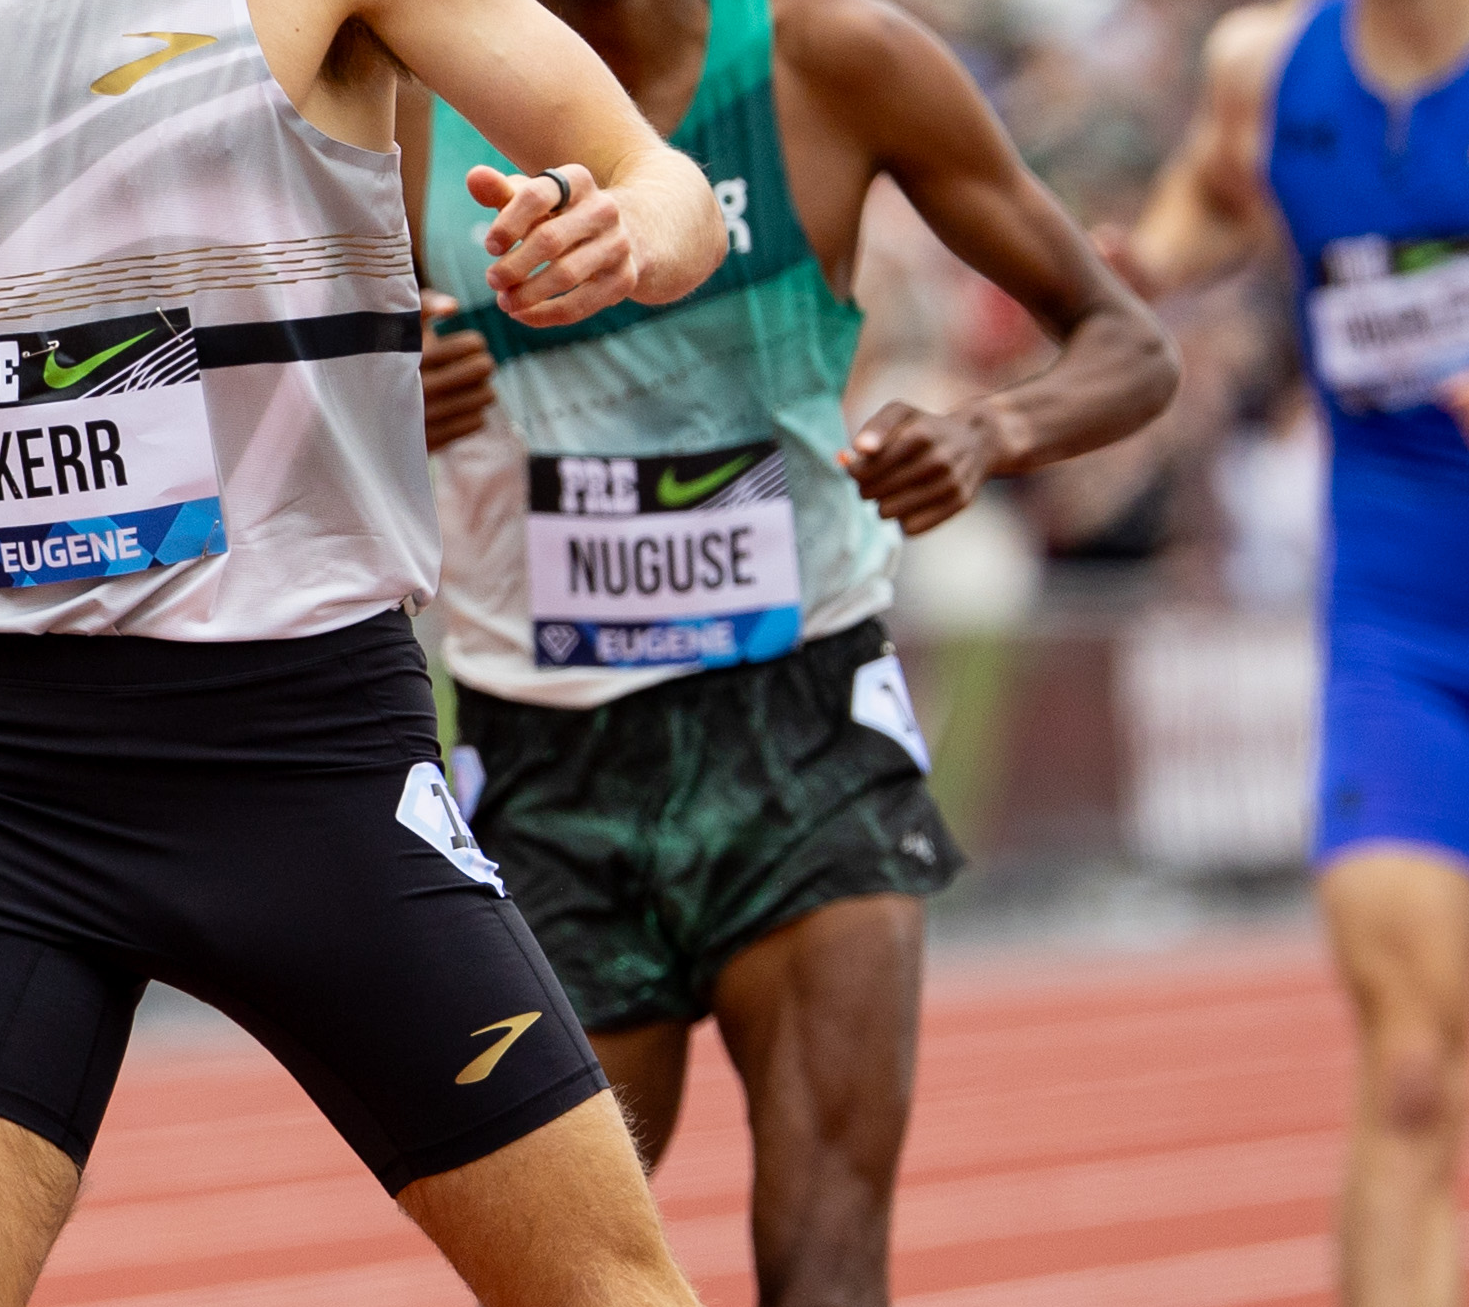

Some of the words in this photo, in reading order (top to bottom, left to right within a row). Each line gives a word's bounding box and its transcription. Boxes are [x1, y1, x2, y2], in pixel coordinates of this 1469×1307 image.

[559, 457, 639, 514] PRE
[0, 527, 142, 573] EUGENE
[568, 527, 756, 595] NUGUSE
[595, 622, 740, 663] EUGENE
[431, 783, 479, 850] 1
